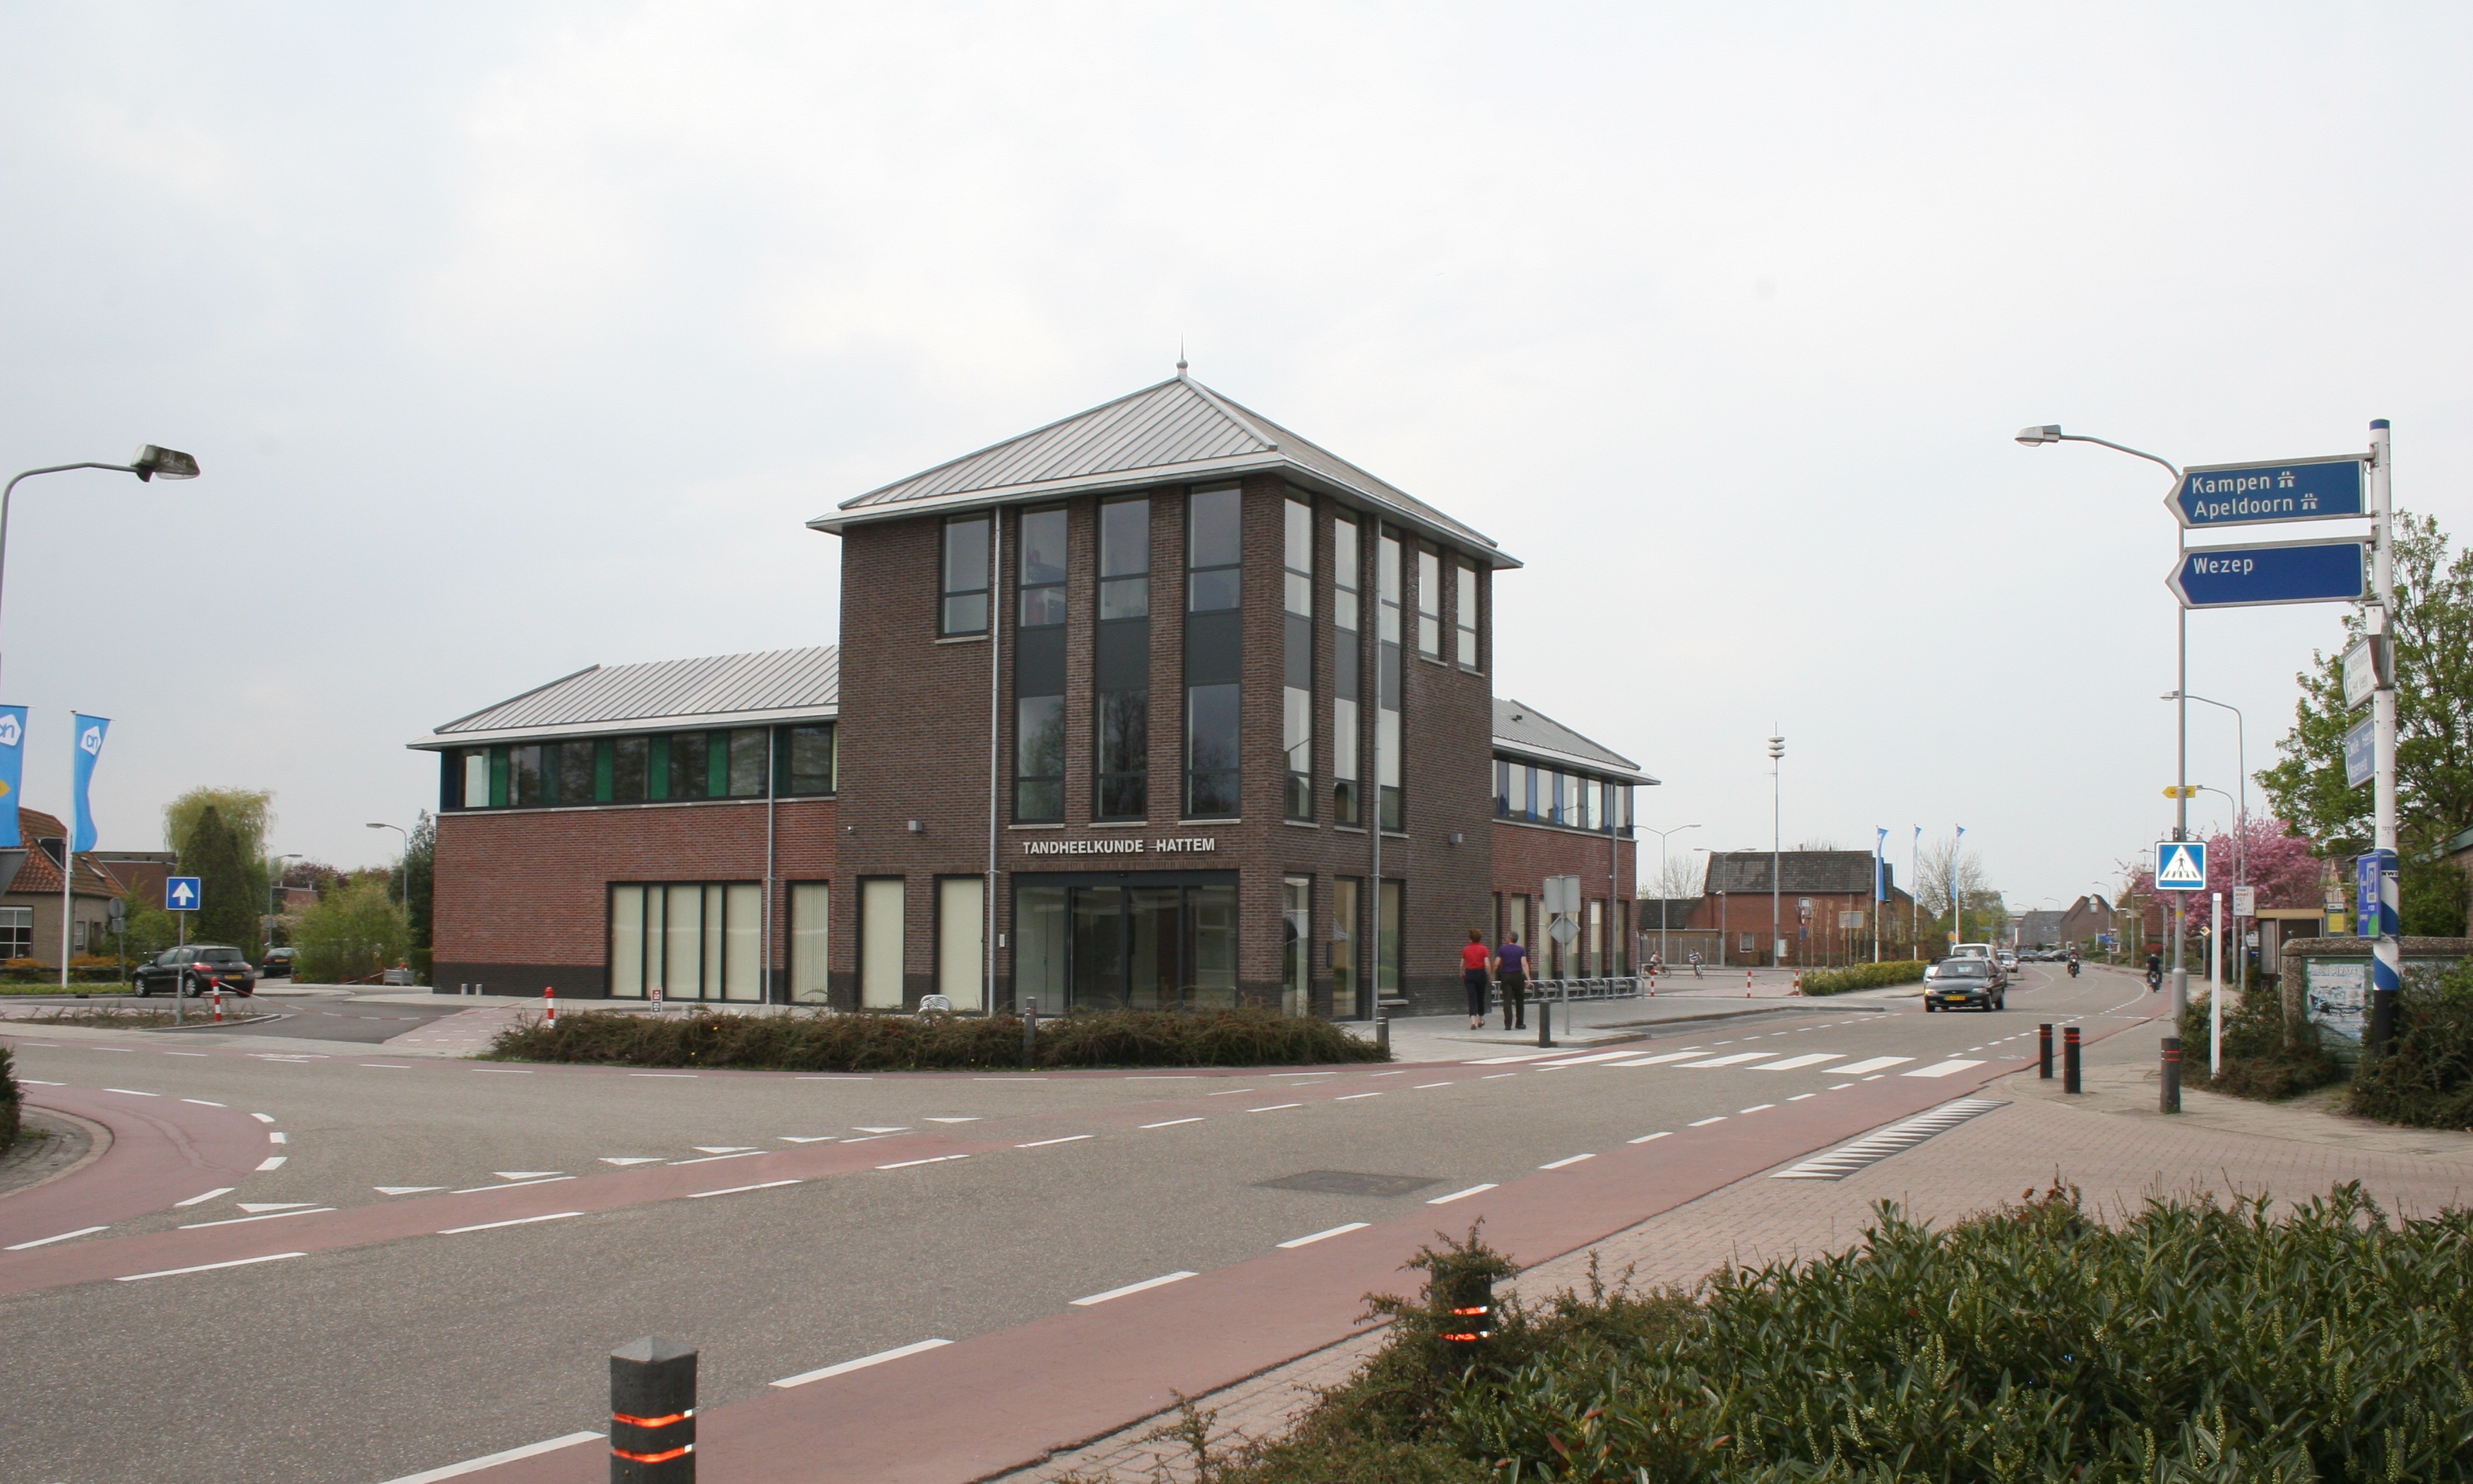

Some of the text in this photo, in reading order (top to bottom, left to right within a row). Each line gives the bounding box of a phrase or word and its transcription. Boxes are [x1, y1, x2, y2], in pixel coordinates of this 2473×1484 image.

[2192, 475, 2270, 495] Kampen
[2193, 497, 2293, 520] Apeldoorn
[2193, 557, 2253, 575] Wezep
[1023, 837, 1215, 854] TANDHEELKUNDE HATTEM
